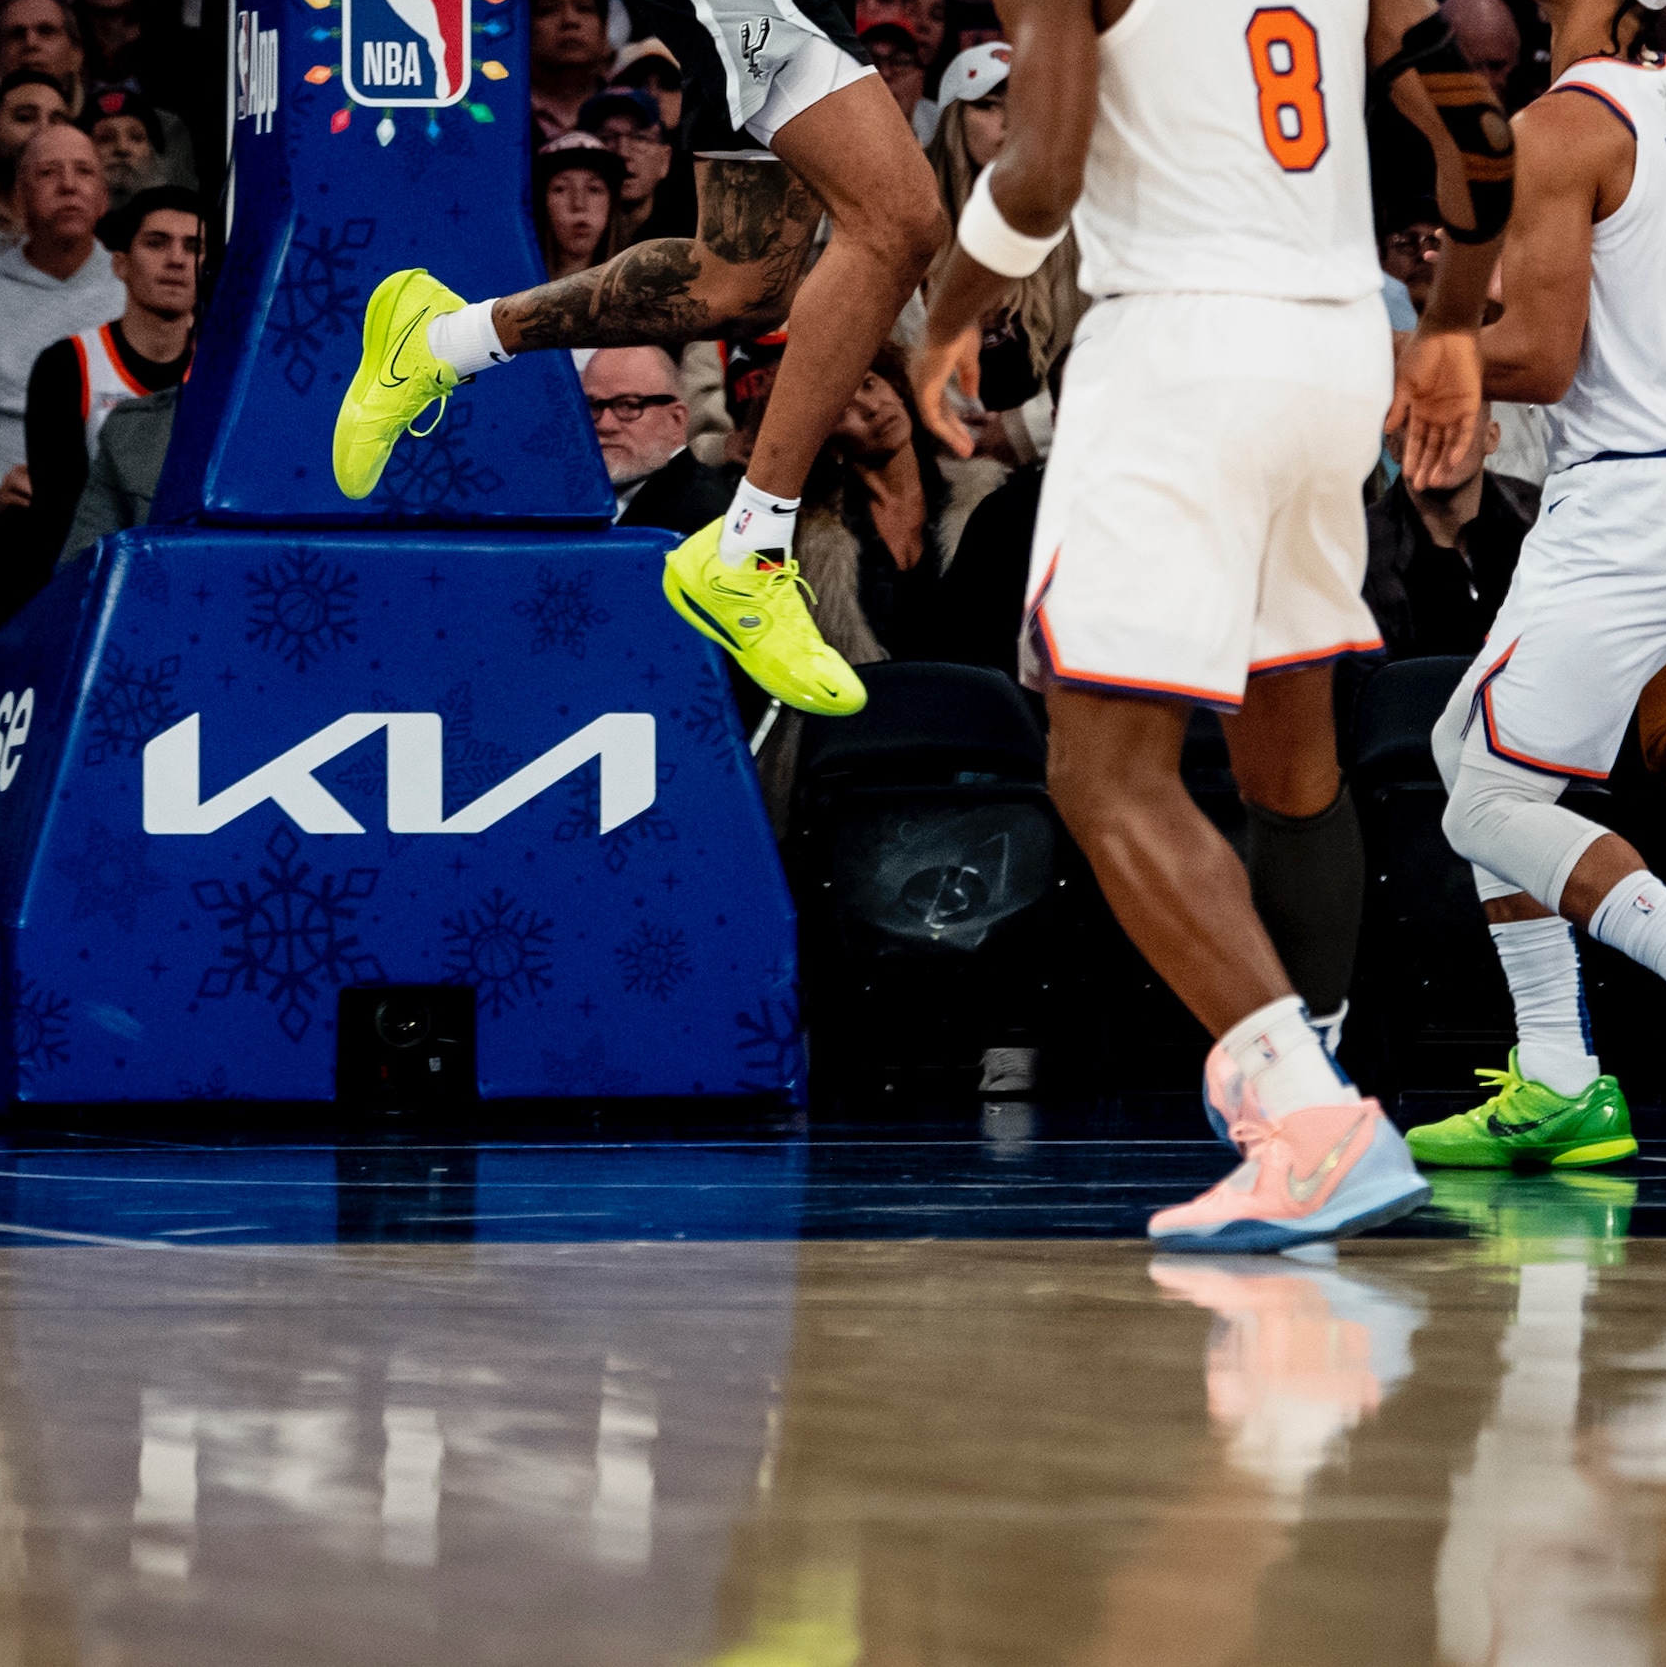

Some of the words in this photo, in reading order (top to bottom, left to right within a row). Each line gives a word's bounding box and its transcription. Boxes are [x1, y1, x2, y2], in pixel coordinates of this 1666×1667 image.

[247, 10, 278, 135] App
[362, 40, 422, 87] NBA
[1245, 6, 1329, 174] 8
[143, 712, 656, 835] KIA
